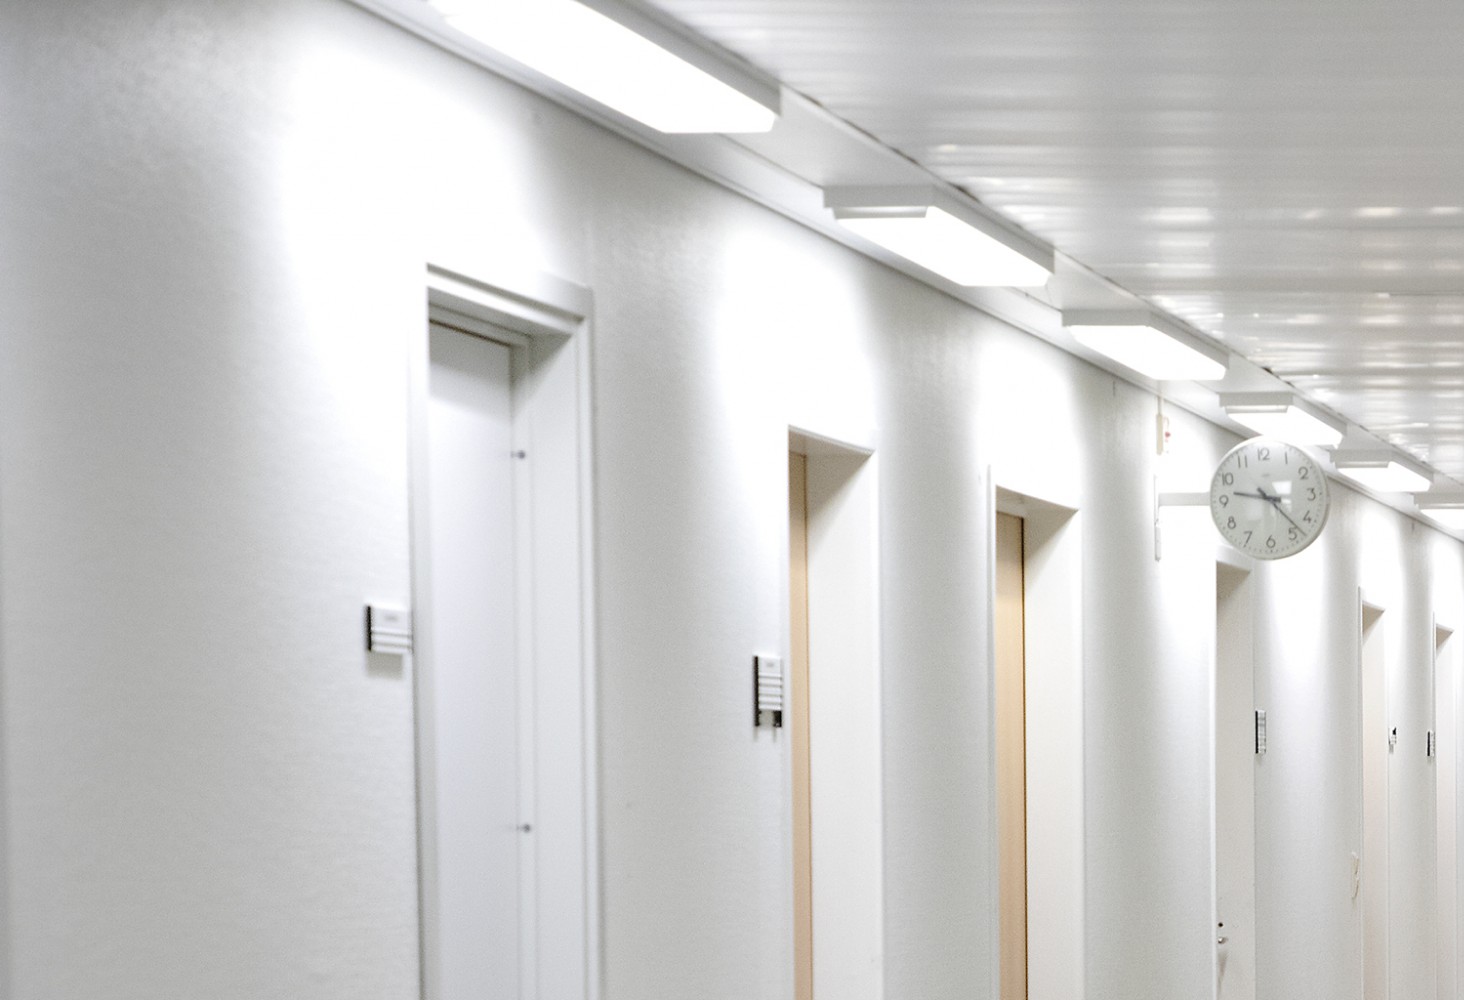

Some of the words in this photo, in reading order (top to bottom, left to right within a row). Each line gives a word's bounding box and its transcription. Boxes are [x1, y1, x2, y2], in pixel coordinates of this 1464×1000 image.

[1258, 448, 1270, 461] 12
[1285, 452, 1288, 465] 1
[1237, 455, 1248, 468] 11
[1222, 473, 1234, 486] 10
[1298, 467, 1308, 480] 2
[1307, 488, 1316, 501] 3
[1219, 495, 1229, 508] 9
[1228, 516, 1236, 529] 8
[1303, 511, 1311, 523] 4
[1244, 531, 1253, 547] 7
[1288, 527, 1298, 541] 5
[1266, 535, 1276, 548] 6
